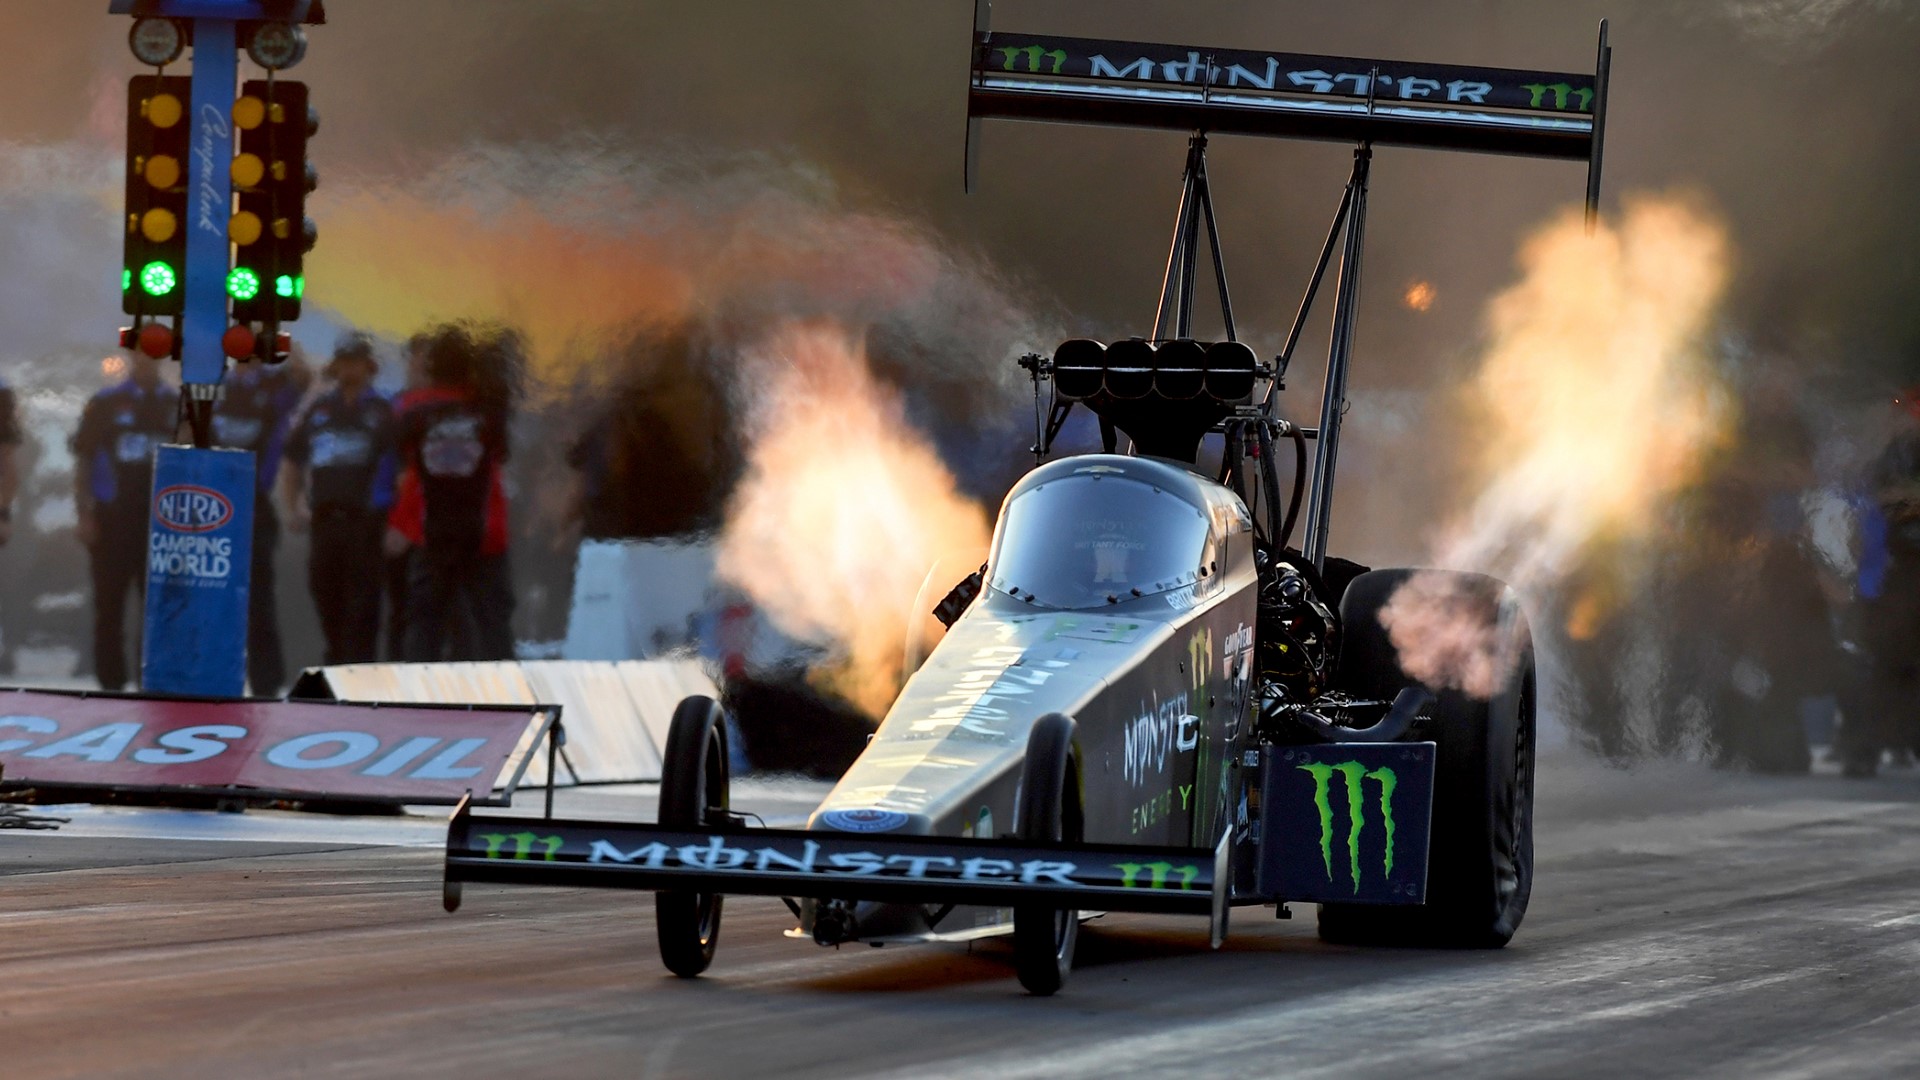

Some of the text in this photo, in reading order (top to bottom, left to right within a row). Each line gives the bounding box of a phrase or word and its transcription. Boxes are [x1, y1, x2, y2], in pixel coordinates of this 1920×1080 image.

[1088, 51, 1493, 103] MONSTER
[160, 491, 221, 524] NHRA
[151, 531, 232, 557] CAMPING
[151, 552, 231, 578] WORLD
[264, 730, 489, 780] OIL
[587, 835, 1084, 886] MONSTER
